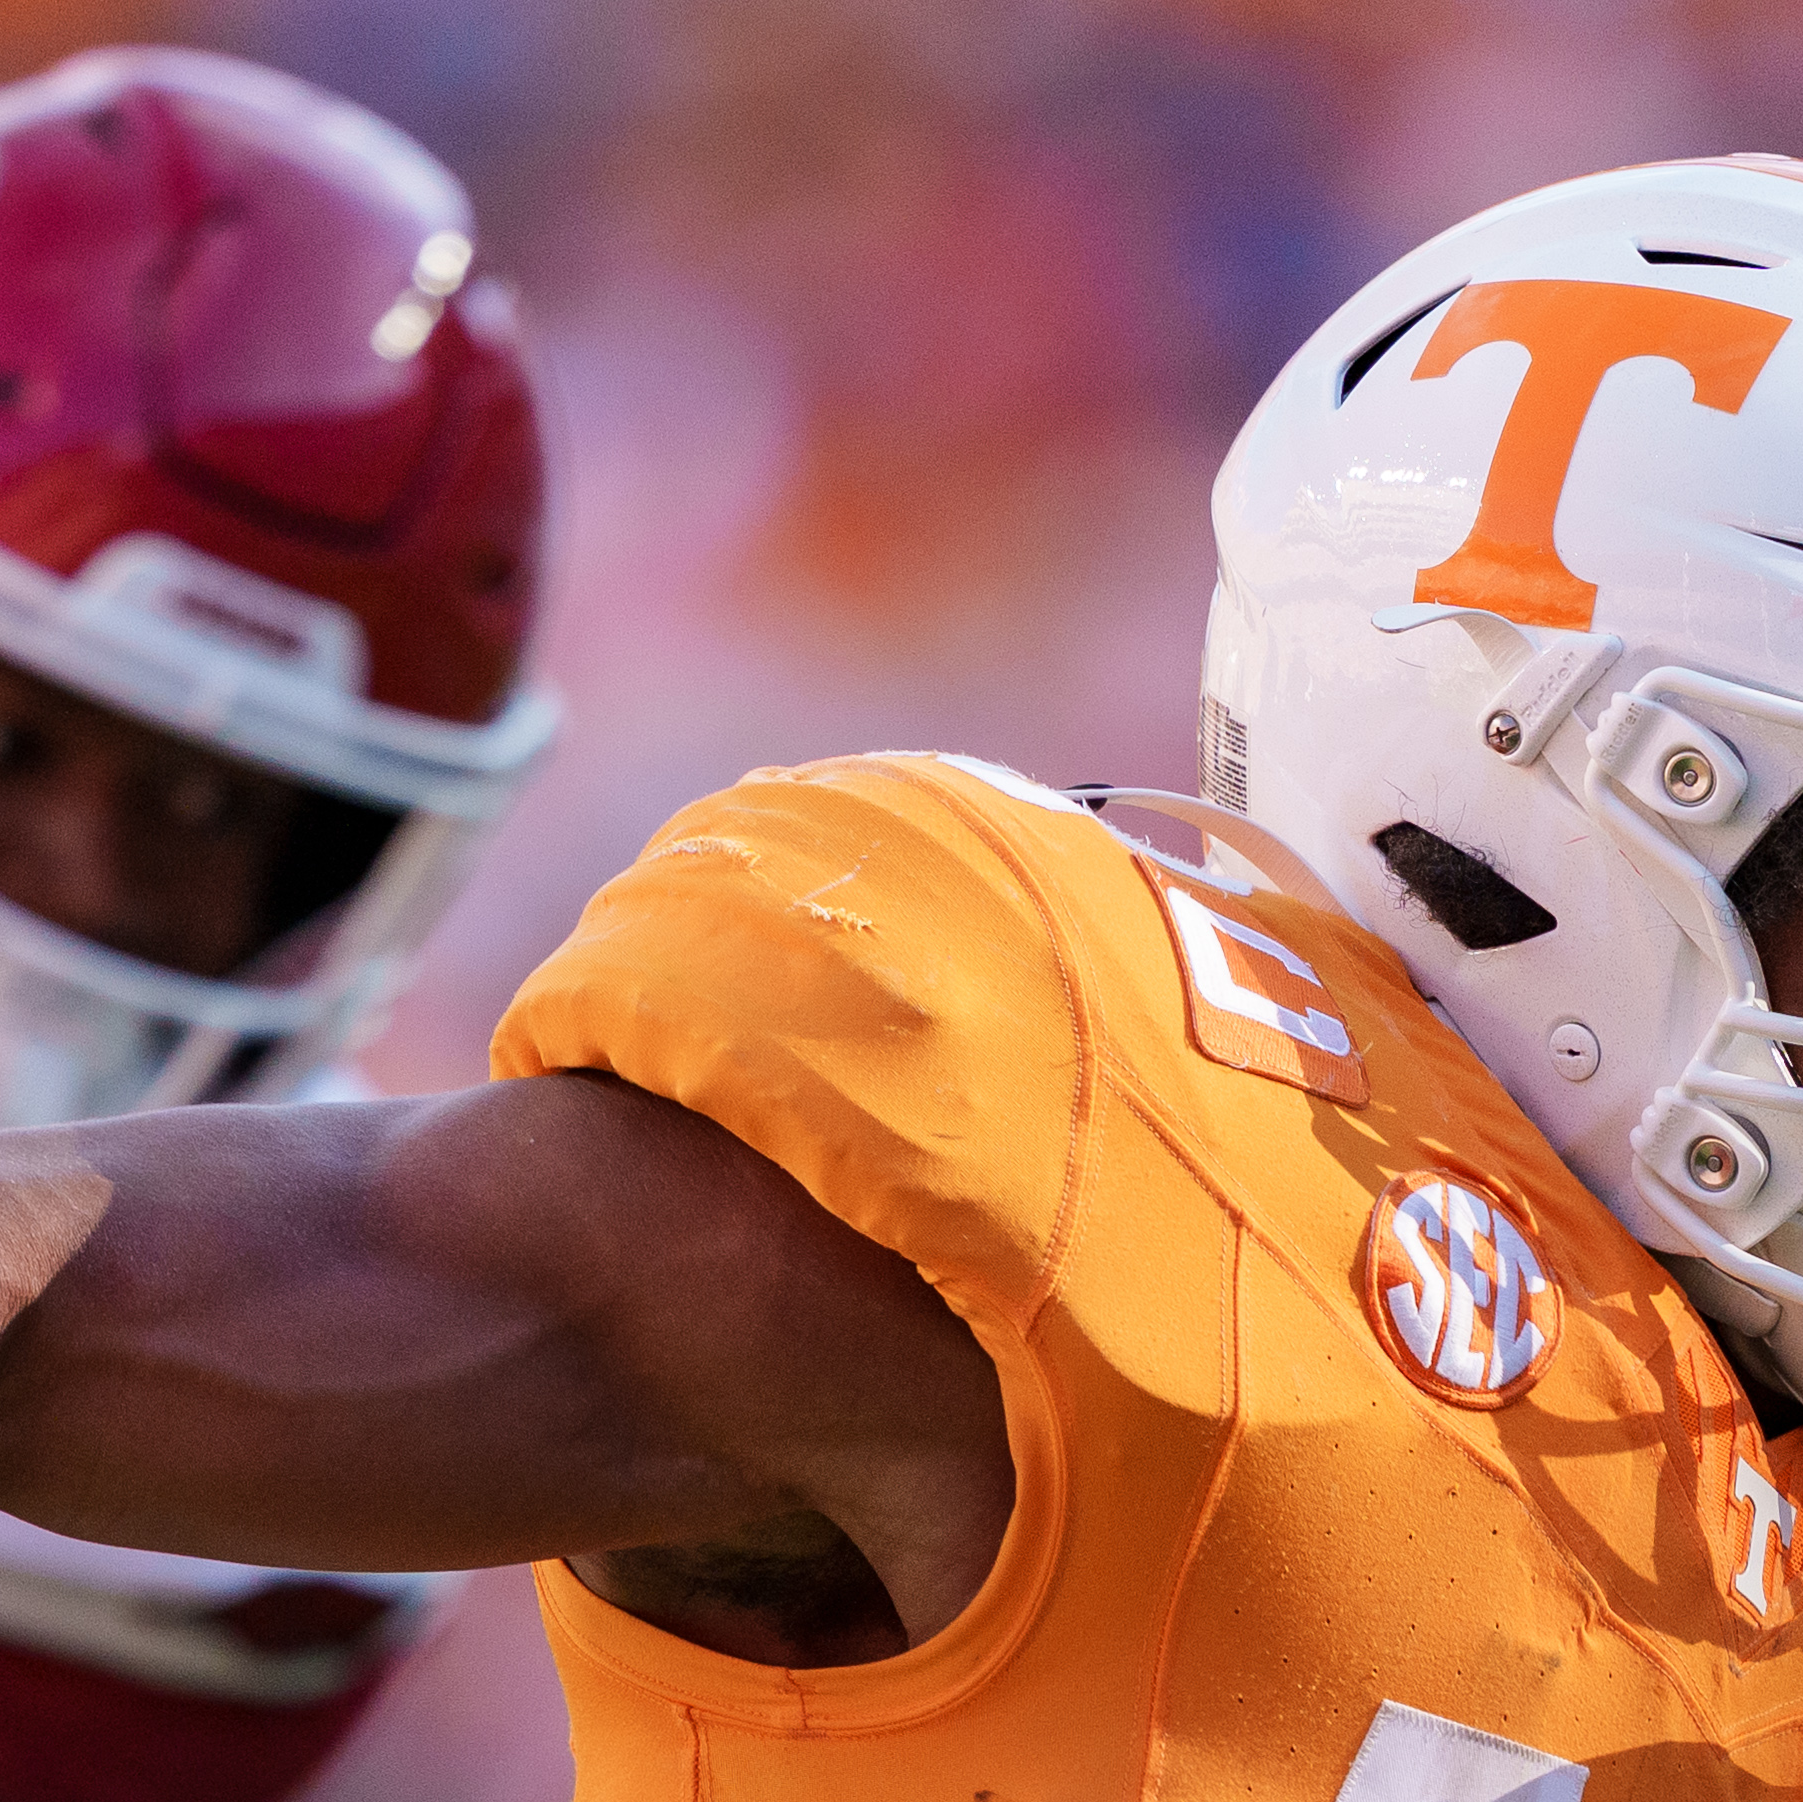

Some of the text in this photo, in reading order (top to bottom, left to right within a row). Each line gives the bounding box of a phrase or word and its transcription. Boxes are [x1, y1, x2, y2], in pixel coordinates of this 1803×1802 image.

[1411, 278, 1793, 632] T
[1167, 886, 1350, 1057] C
[1387, 1182, 1546, 1389] SEC
[1734, 1456, 1797, 1617] T
